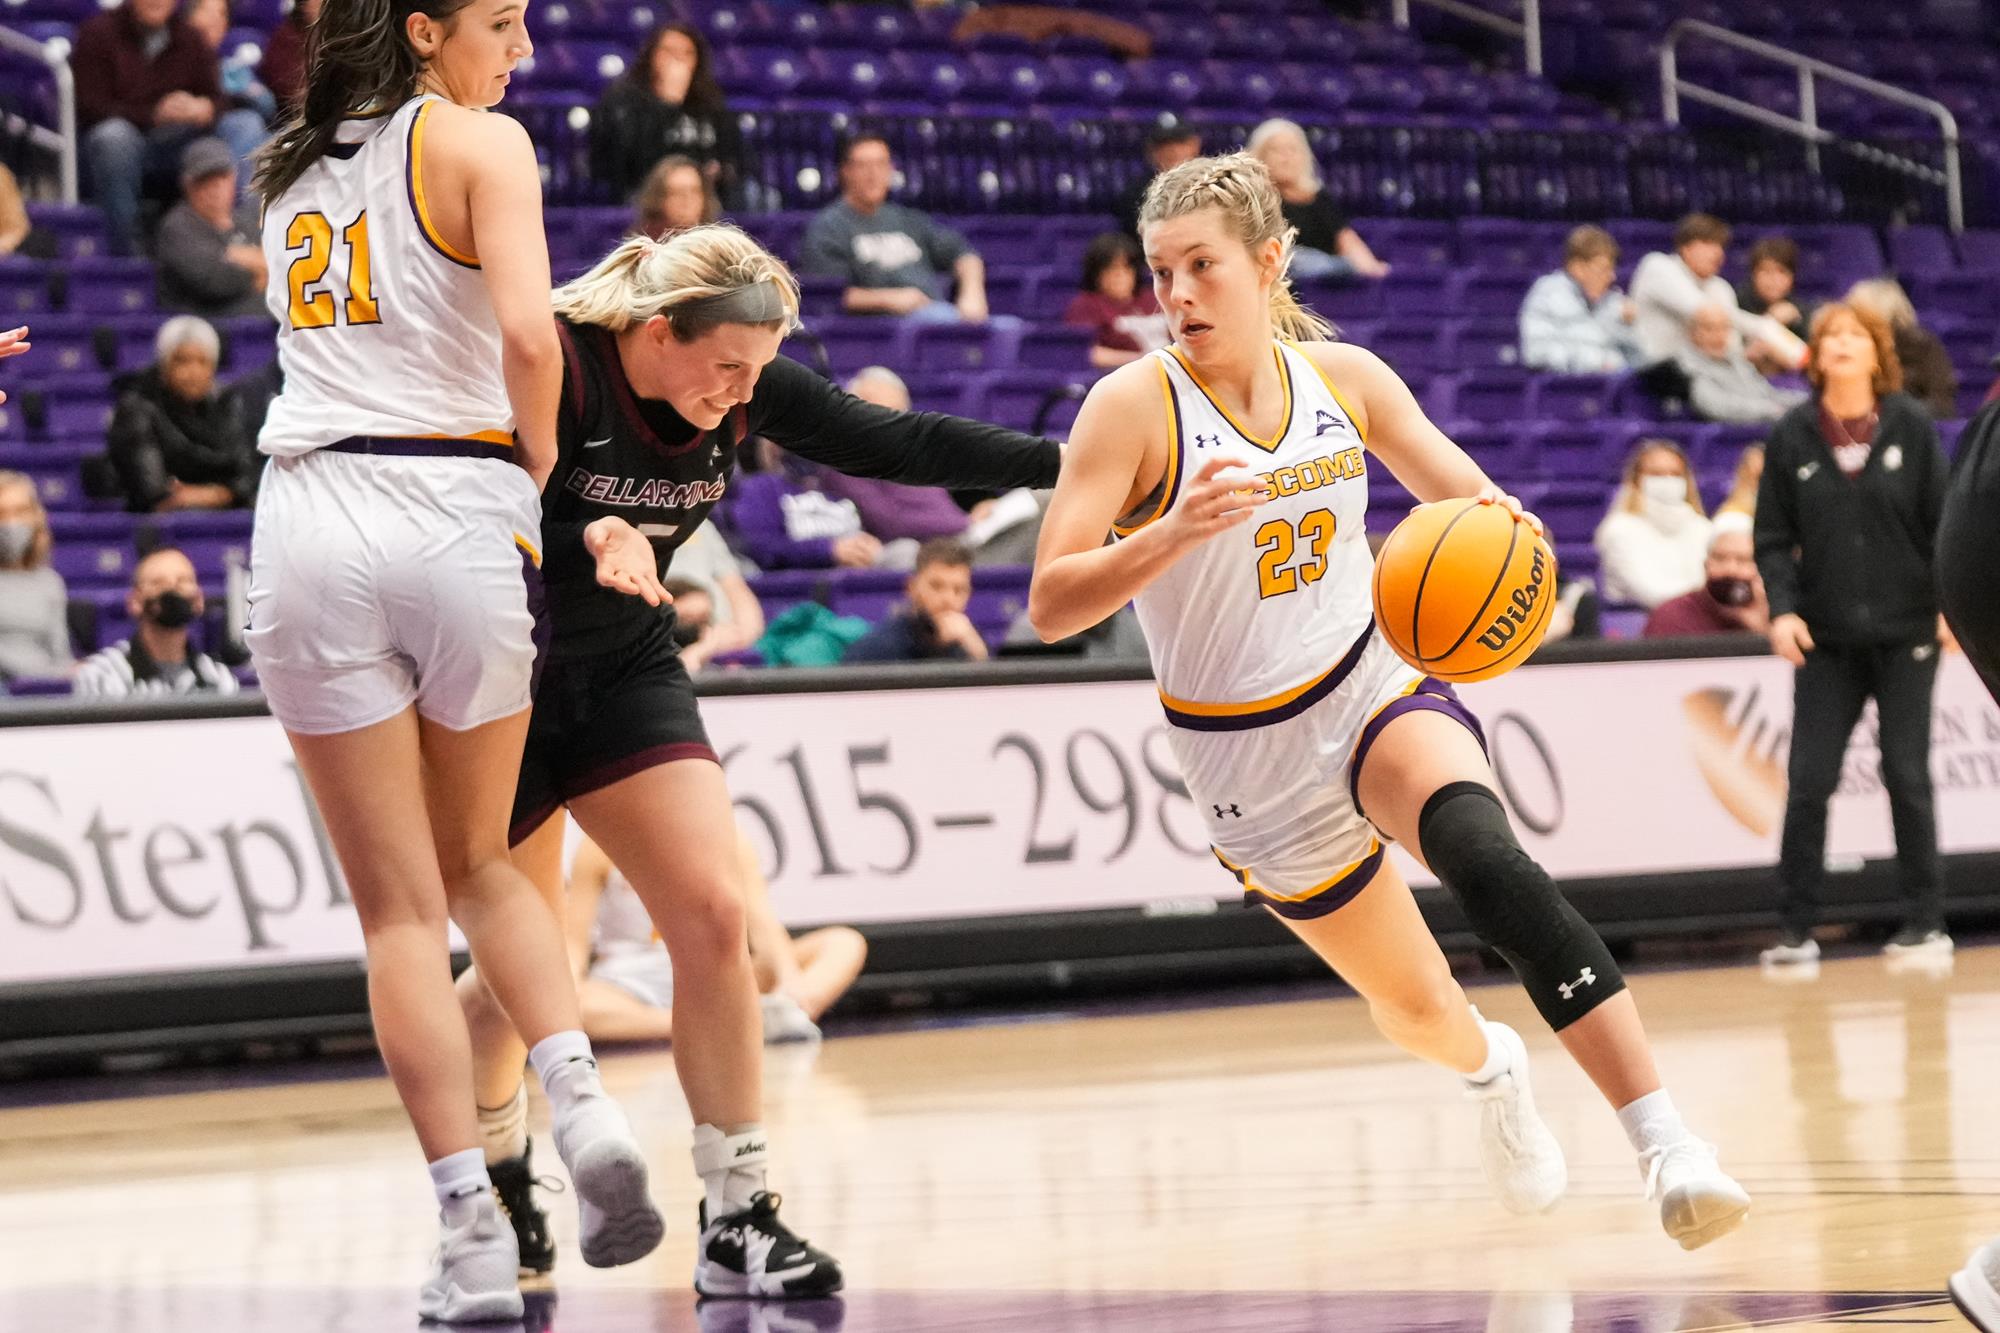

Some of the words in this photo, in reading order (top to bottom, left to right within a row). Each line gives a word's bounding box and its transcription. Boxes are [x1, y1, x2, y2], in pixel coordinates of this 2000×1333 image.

[286, 208, 383, 331] 21
[1233, 446, 1366, 502] SCOMB
[1254, 507, 1337, 601] 23
[1476, 546, 1544, 650] Wilson
